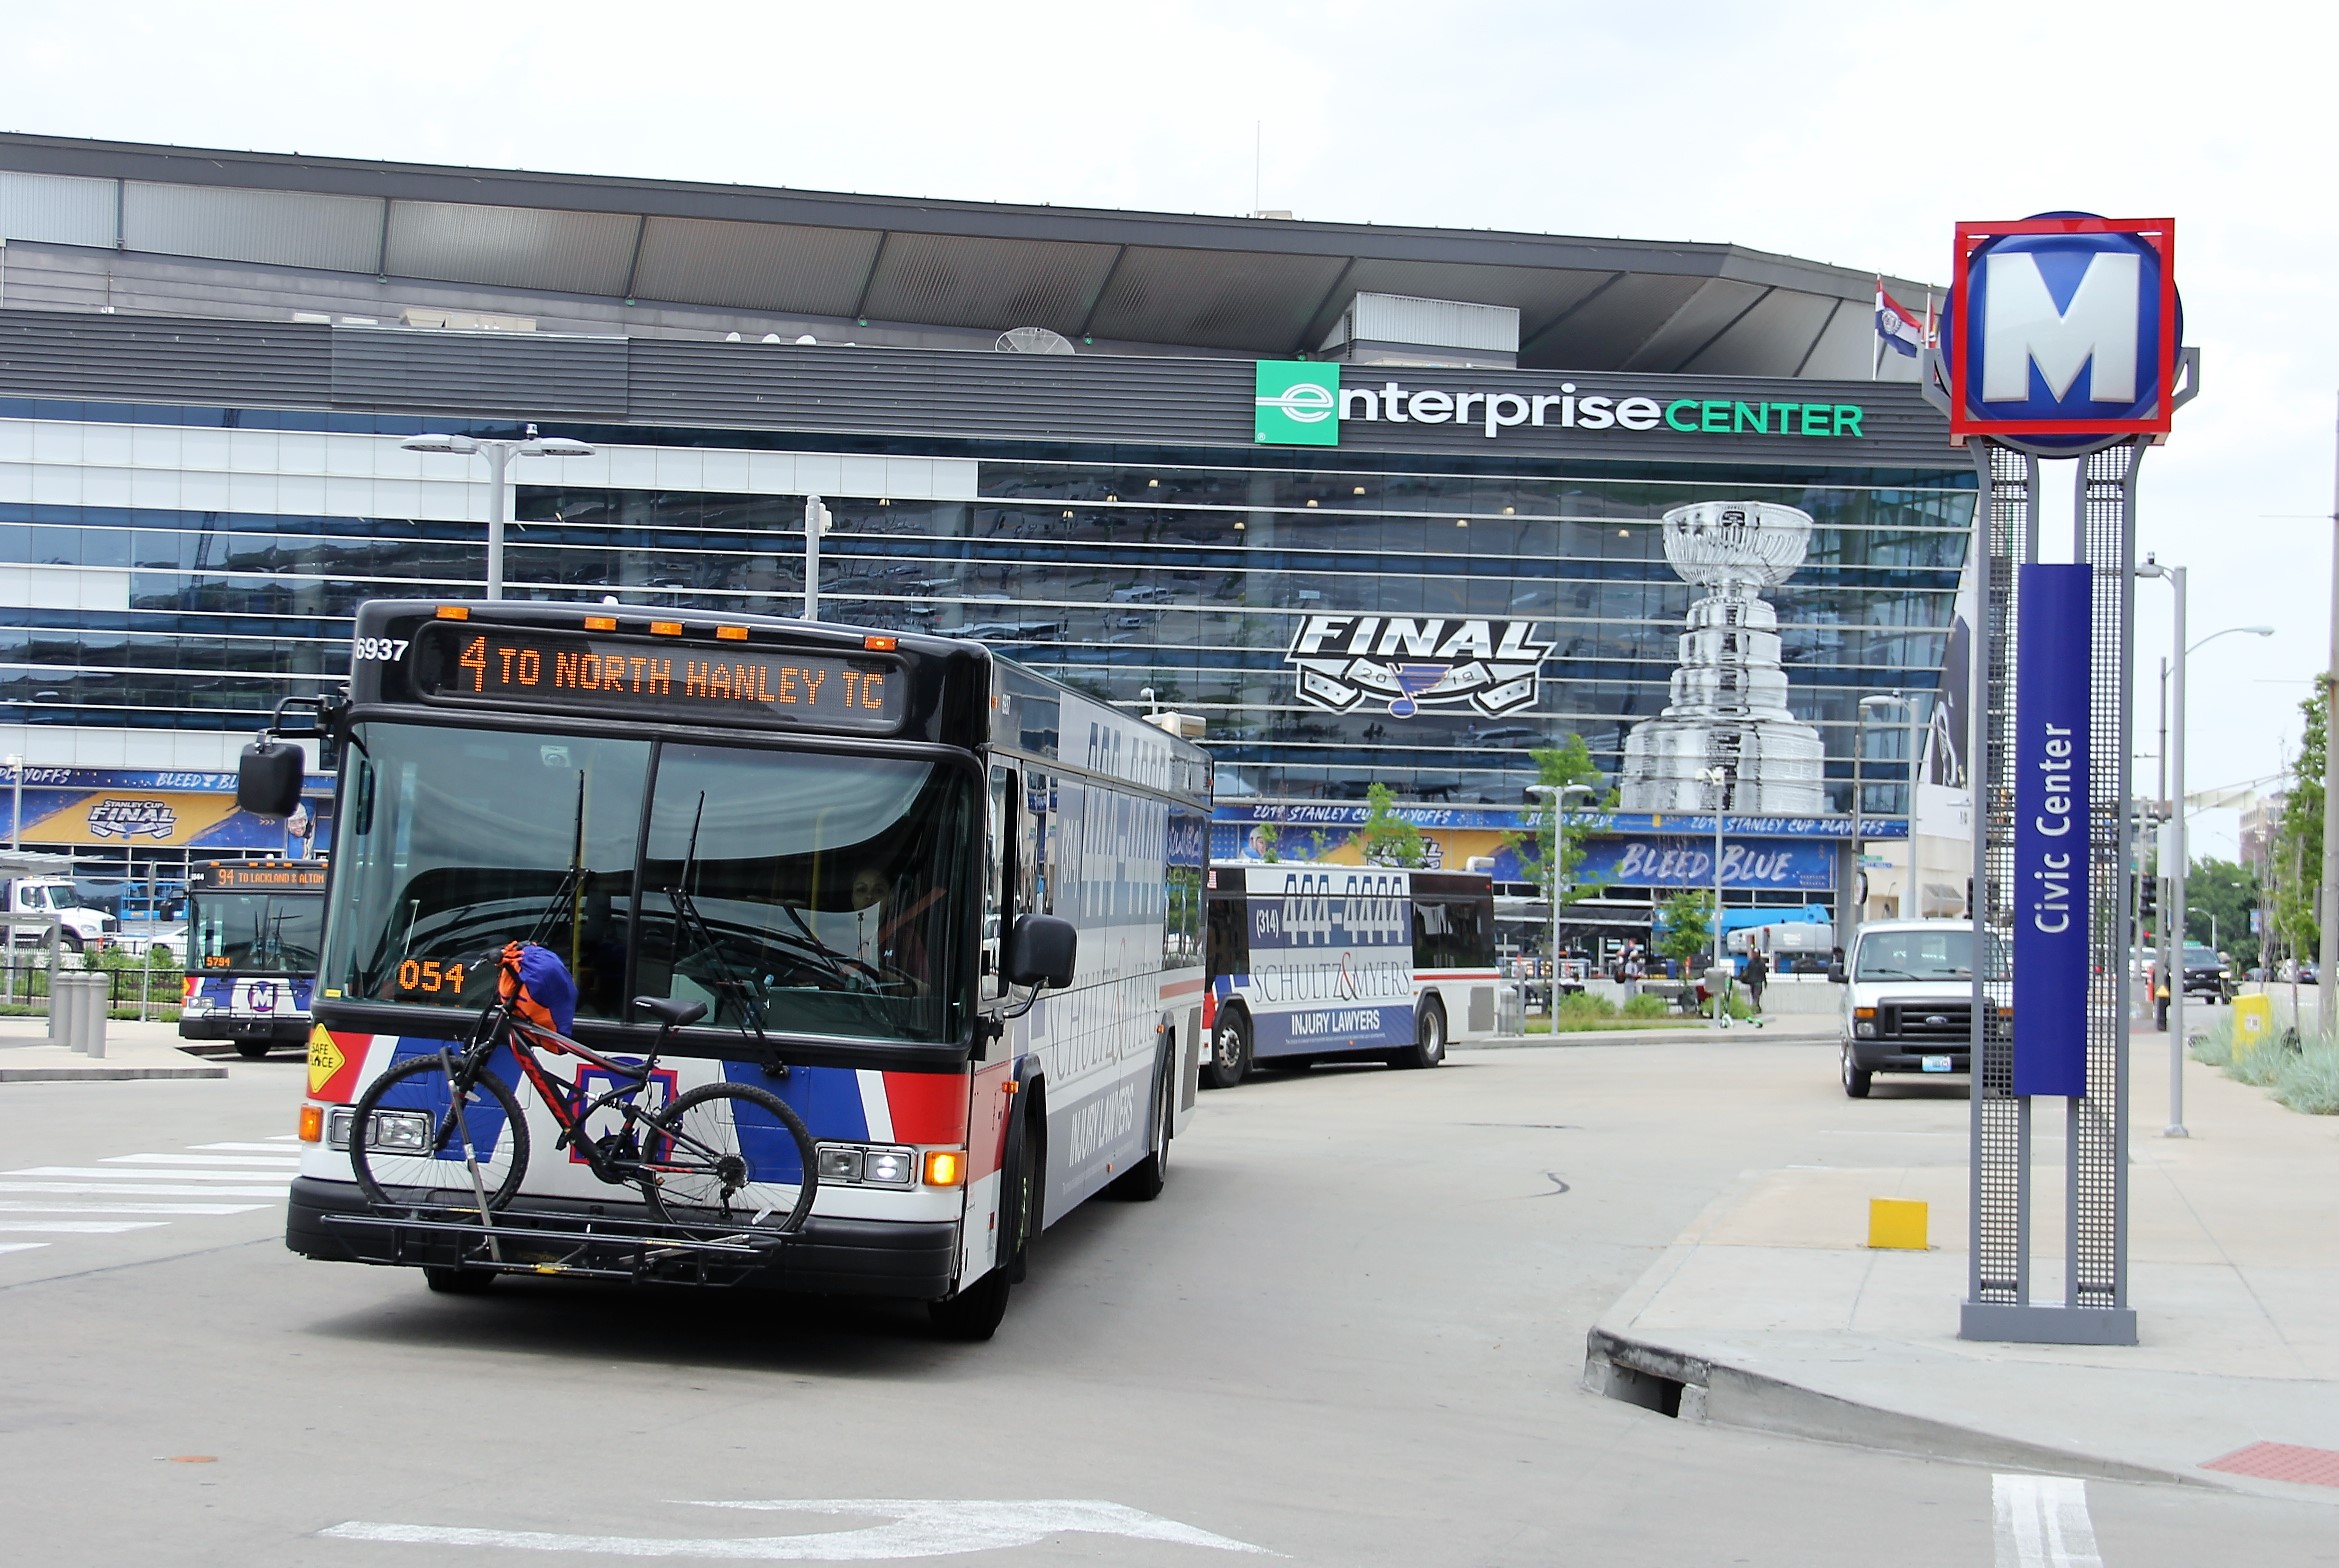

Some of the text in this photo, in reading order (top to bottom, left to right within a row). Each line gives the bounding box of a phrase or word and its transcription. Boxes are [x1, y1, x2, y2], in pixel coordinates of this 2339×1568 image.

[1982, 252, 2140, 404] M
[1281, 381, 1864, 438] enterprise CENTER
[356, 637, 410, 662] 6937
[1297, 615, 1547, 660] FINAL
[460, 635, 884, 710] 4 TO NORTH HANLEY TC
[0, 767, 71, 784] PLYOFFS
[156, 772, 202, 787] BLEED
[89, 806, 177, 822] FINAL
[144, 801, 164, 809] CUP
[1254, 804, 1285, 819] 2019
[1287, 805, 1350, 822] STANLEY
[1723, 817, 1785, 832] STANLEY
[1787, 819, 1815, 833] CUP
[1820, 819, 1886, 835] PLAYFFS
[2033, 722, 2072, 933] Civic Center
[218, 868, 235, 886] 94
[238, 873, 249, 882] TO
[251, 872, 290, 883] LACKLAND
[1618, 843, 1793, 883] BLEED BLUE
[1282, 873, 1405, 945] 444-4444
[1256, 909, 1279, 939] (314)
[400, 960, 464, 994] 054
[1291, 1010, 1380, 1036] INJURY LAWYERS
[311, 1042, 329, 1055] SAFE
[1069, 1095, 1101, 1168] INJURY
[1098, 1082, 1134, 1149] LAWYERS
